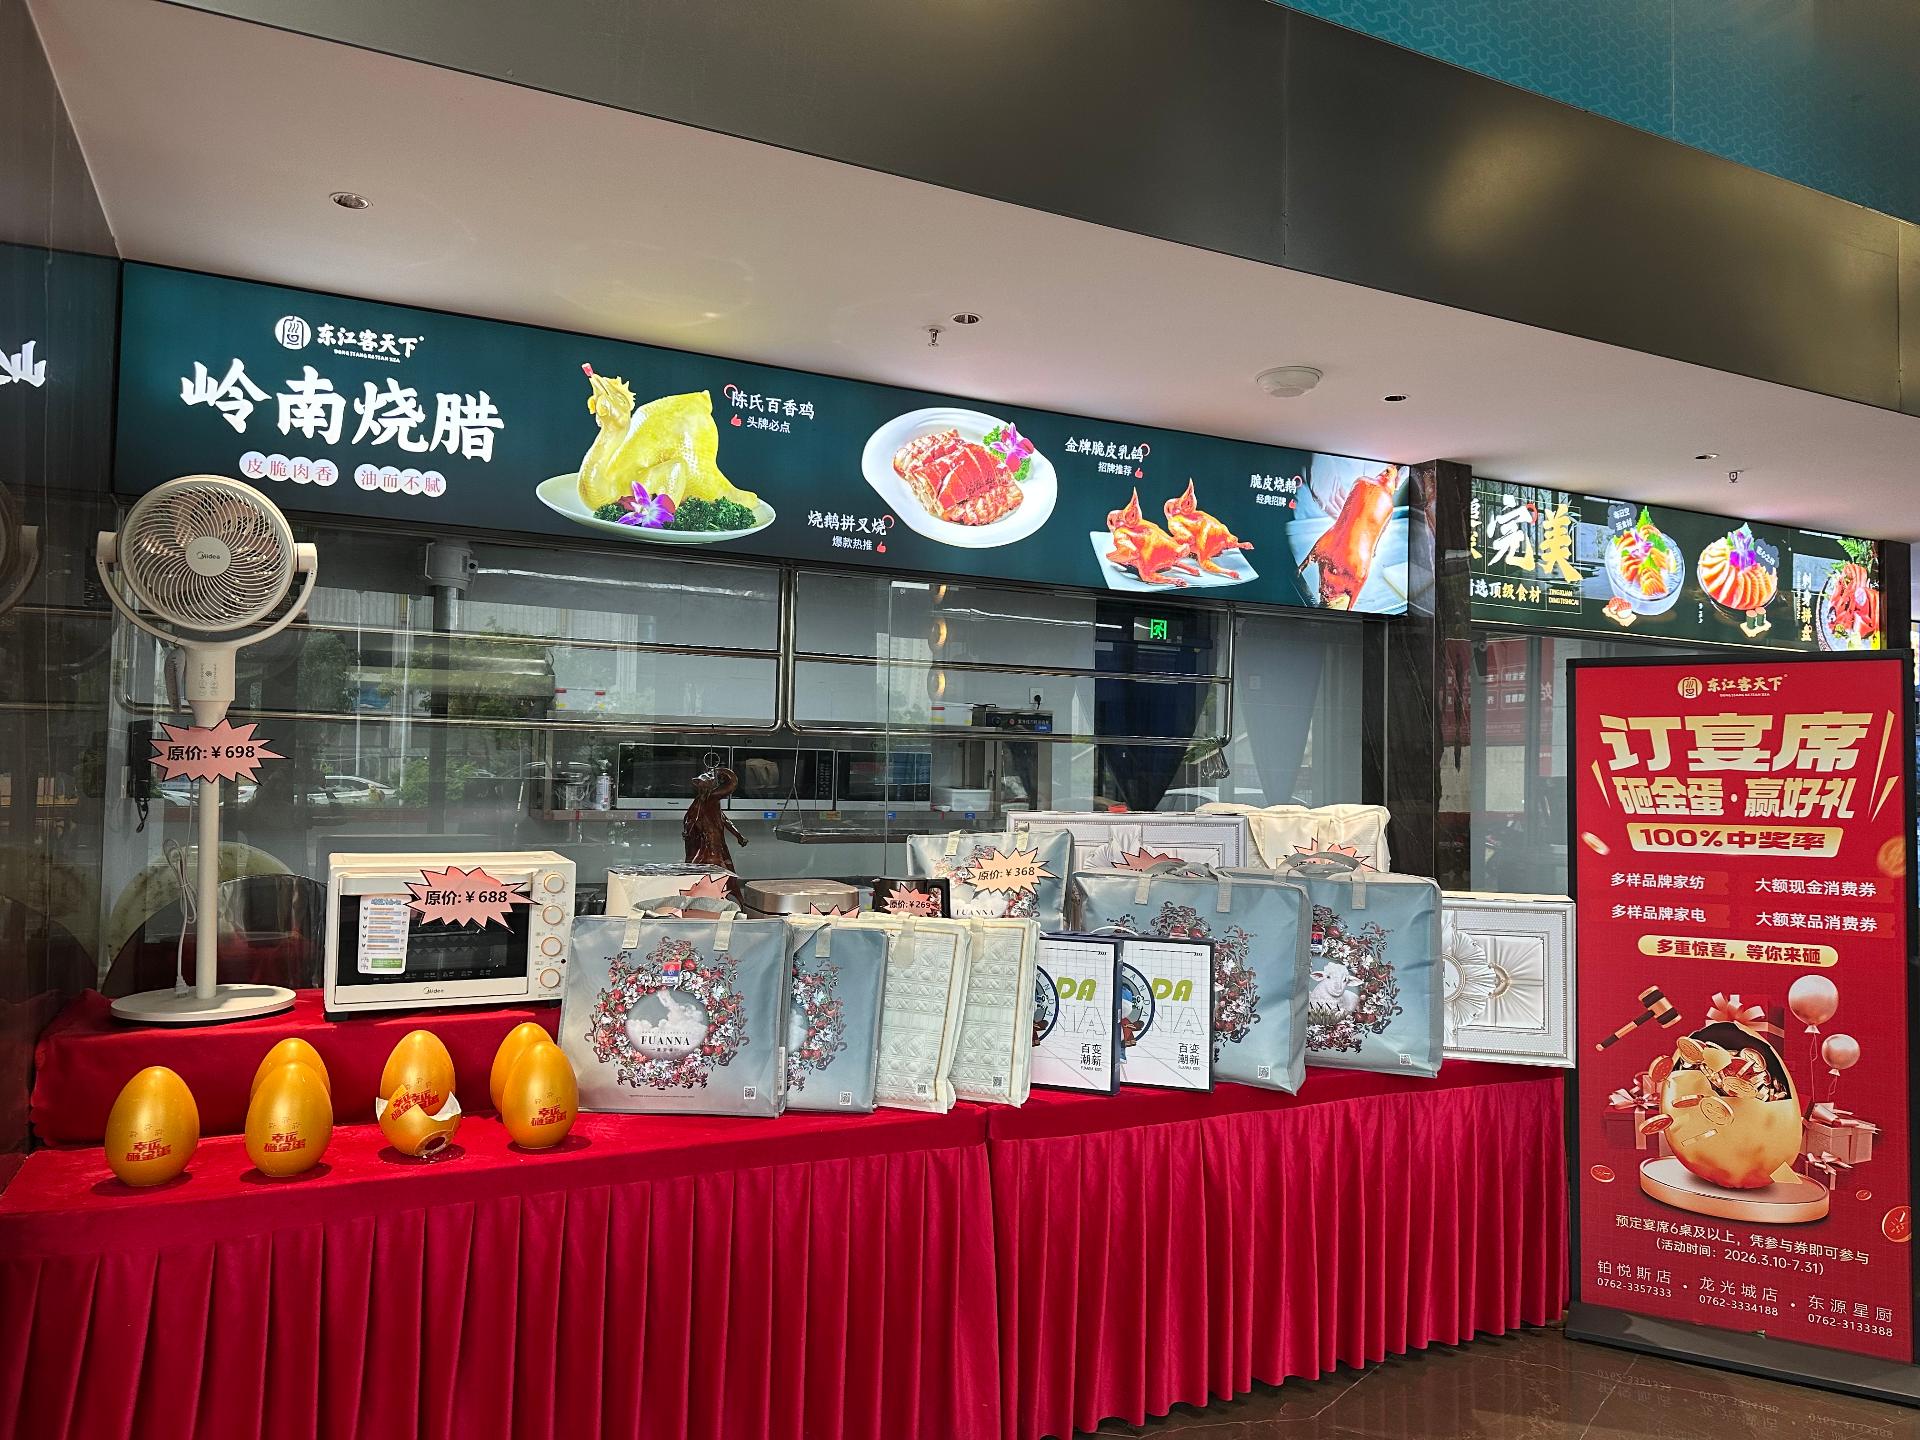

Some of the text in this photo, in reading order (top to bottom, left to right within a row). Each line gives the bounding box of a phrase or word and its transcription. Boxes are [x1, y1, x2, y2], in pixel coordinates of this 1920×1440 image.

[317, 323, 418, 358] 东江客天下
[180, 357, 505, 462] 岭南烧腊
[730, 391, 815, 419] 陈氏百香鸡
[746, 416, 791, 434] 头牌必点
[1065, 436, 1144, 463] 金牌脆皮乳鸽
[247, 459, 441, 493] 皮脆肉香 油而不腻
[1097, 461, 1132, 476] 招牌推荐
[1250, 474, 1297, 494] 脆皮烧鹅
[1256, 494, 1287, 507] 经典招牌
[807, 511, 887, 536] 烧鹅拼叉烧
[831, 536, 873, 552] 爆款热推
[1487, 494, 1583, 583] 完美
[197, 551, 221, 560] Midea
[1470, 578, 1542, 603] 选顶级食材
[1707, 677, 1783, 693] 东江客天下
[1600, 711, 1874, 772] 订宴席
[1612, 777, 1859, 819] 砸金蛋·赢好礼
[1640, 828, 1827, 850] 100%中奖率
[1610, 872, 1877, 898] 多样品牌家纺 大额现金消费券
[1611, 904, 1878, 933] 多样品牌家电 大额菜品消费券
[1656, 938, 1822, 965] 多重惊喜，等你来砸
[641, 1036, 690, 1046] FUANNA
[1615, 1214, 1870, 1265] 预定宴席6桌及以上，凭参与券即可参与
[1597, 1260, 1893, 1323] 铂悦斯店 龙光城店 东源星厨
[1597, 1277, 1893, 1337] 0762-3357333 0762-3334188 0762-3133388
